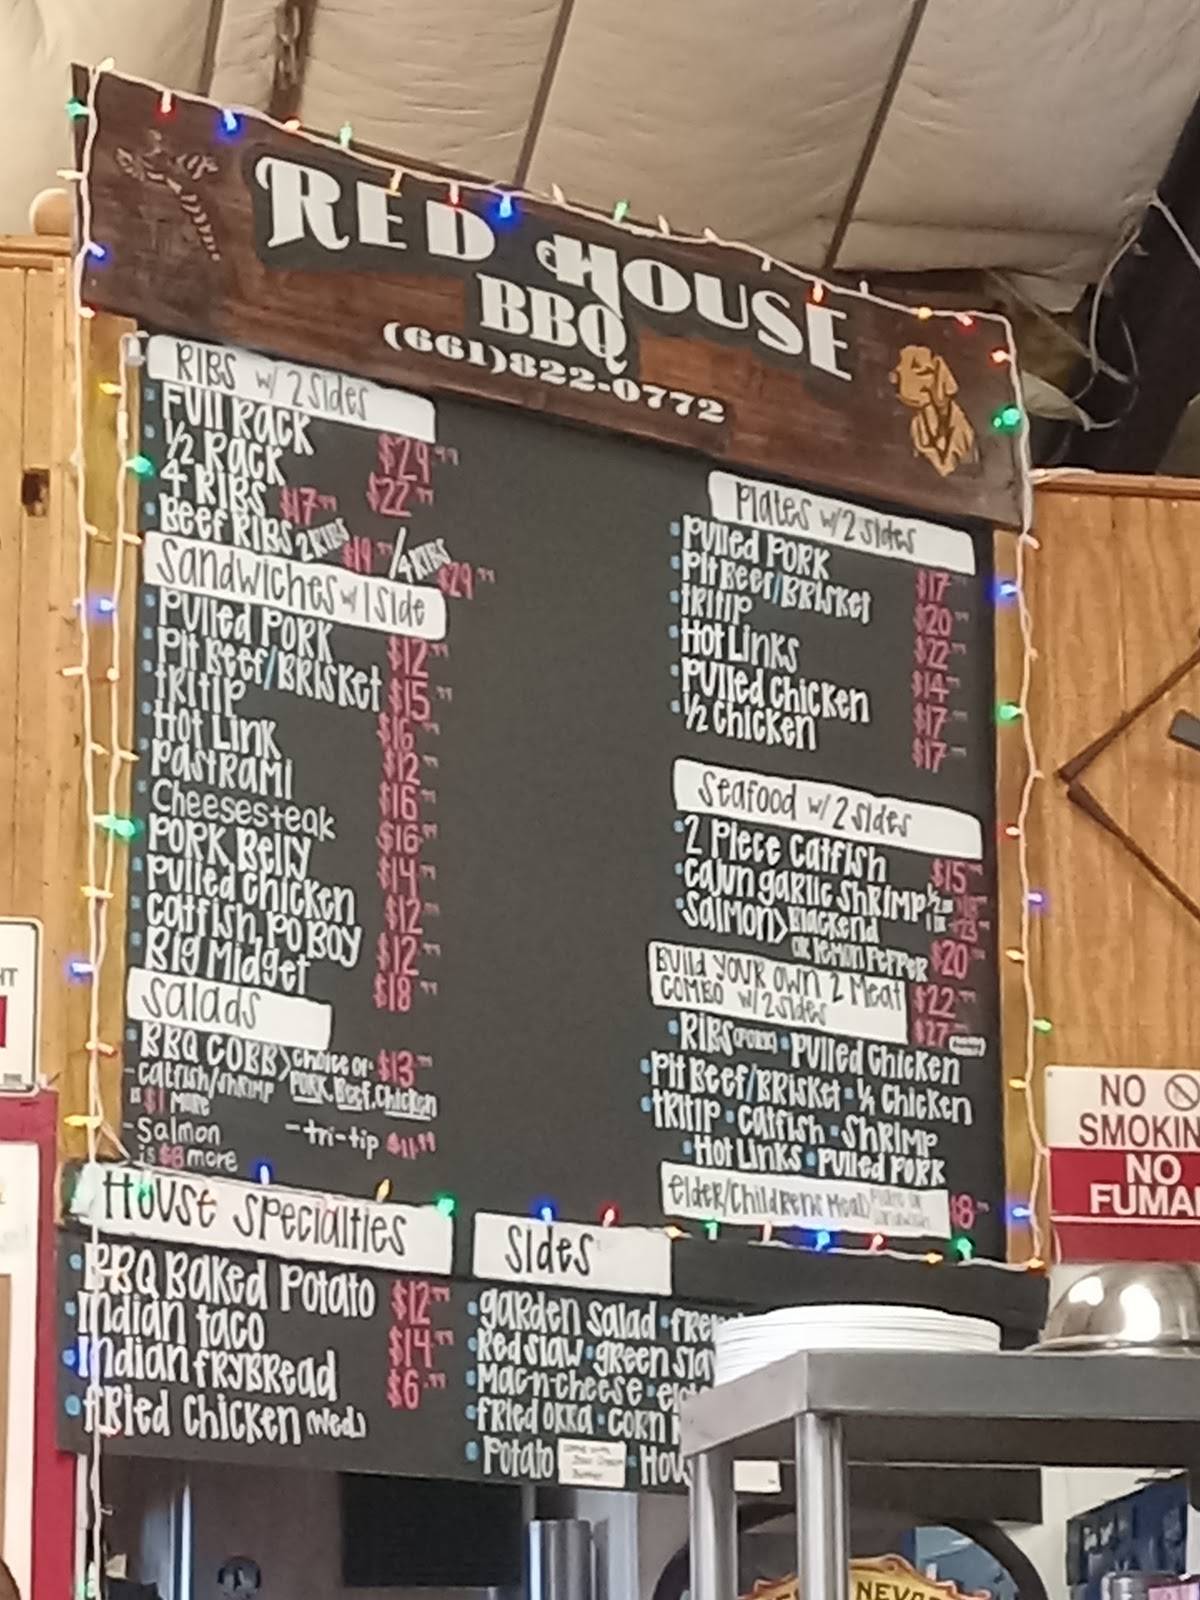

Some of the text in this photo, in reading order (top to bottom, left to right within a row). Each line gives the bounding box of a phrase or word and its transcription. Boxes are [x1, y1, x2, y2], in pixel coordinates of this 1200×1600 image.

[255, 156, 853, 381] RED HOUSE
[476, 272, 628, 375] BBQ
[176, 343, 237, 391] RIBS
[287, 371, 302, 406] 2
[383, 321, 725, 425] (661)822-0772
[160, 459, 267, 517] 4 RIBS
[736, 482, 813, 531] Plates
[158, 493, 228, 542] Beef
[232, 507, 294, 556] RIBS
[157, 538, 338, 616] Sandwiches
[153, 699, 203, 749] Hot
[151, 778, 337, 842] Cheesesteak
[698, 771, 798, 821] Seafood
[236, 826, 312, 880] Belly
[683, 814, 703, 856] 2
[206, 935, 312, 995] Midget
[141, 977, 262, 1029] Salads
[850, 975, 903, 1012] Meat
[139, 1020, 199, 1062] BBQ
[1101, 1074, 1146, 1107] NO
[136, 1115, 221, 1146] Salmon
[187, 1148, 239, 1173] more
[1125, 1153, 1182, 1186] NO
[102, 1171, 408, 1256] House Specialties
[505, 1224, 595, 1276] Sides
[164, 1249, 269, 1311] Baked
[278, 1261, 376, 1319] Potato
[77, 1291, 187, 1343] Indian
[77, 1335, 190, 1385] Indian
[482, 1435, 555, 1479] Potato
